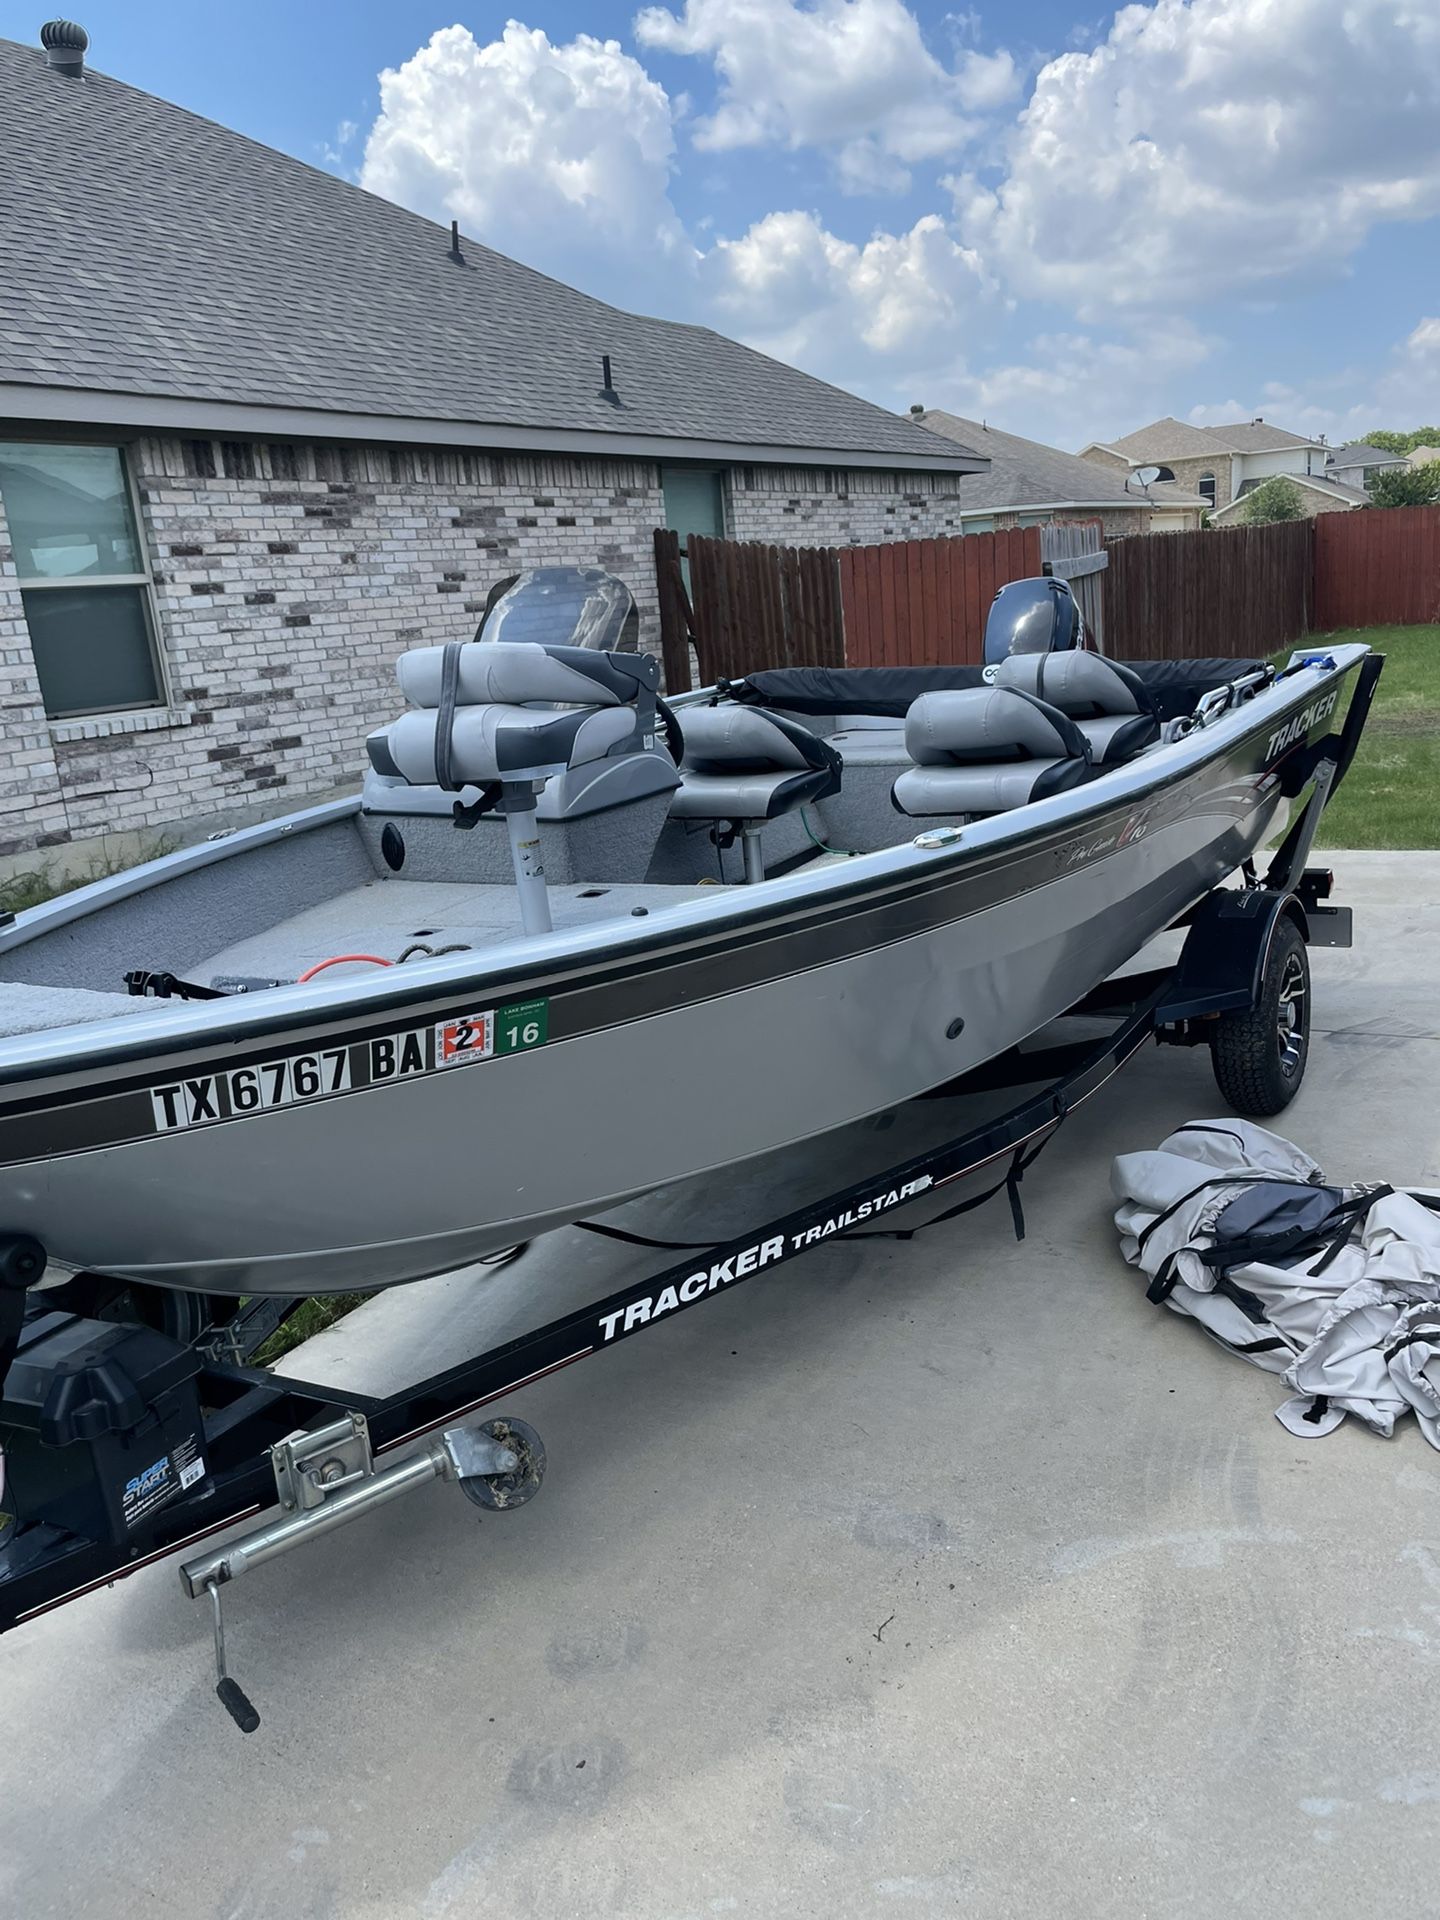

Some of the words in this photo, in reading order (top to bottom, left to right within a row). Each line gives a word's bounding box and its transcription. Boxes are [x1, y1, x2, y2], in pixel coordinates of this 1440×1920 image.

[1265, 690, 1337, 762] TRACKER
[456, 1025, 474, 1051] 2
[506, 1022, 539, 1048] 16
[154, 1077, 218, 1128] TX
[231, 1049, 348, 1111] 6767
[370, 1033, 424, 1081] BA
[598, 1234, 786, 1341] TRACKER
[791, 1184, 916, 1251] TRAILSTAR
[123, 1464, 170, 1507] START
[126, 1456, 169, 1492] SUPER
